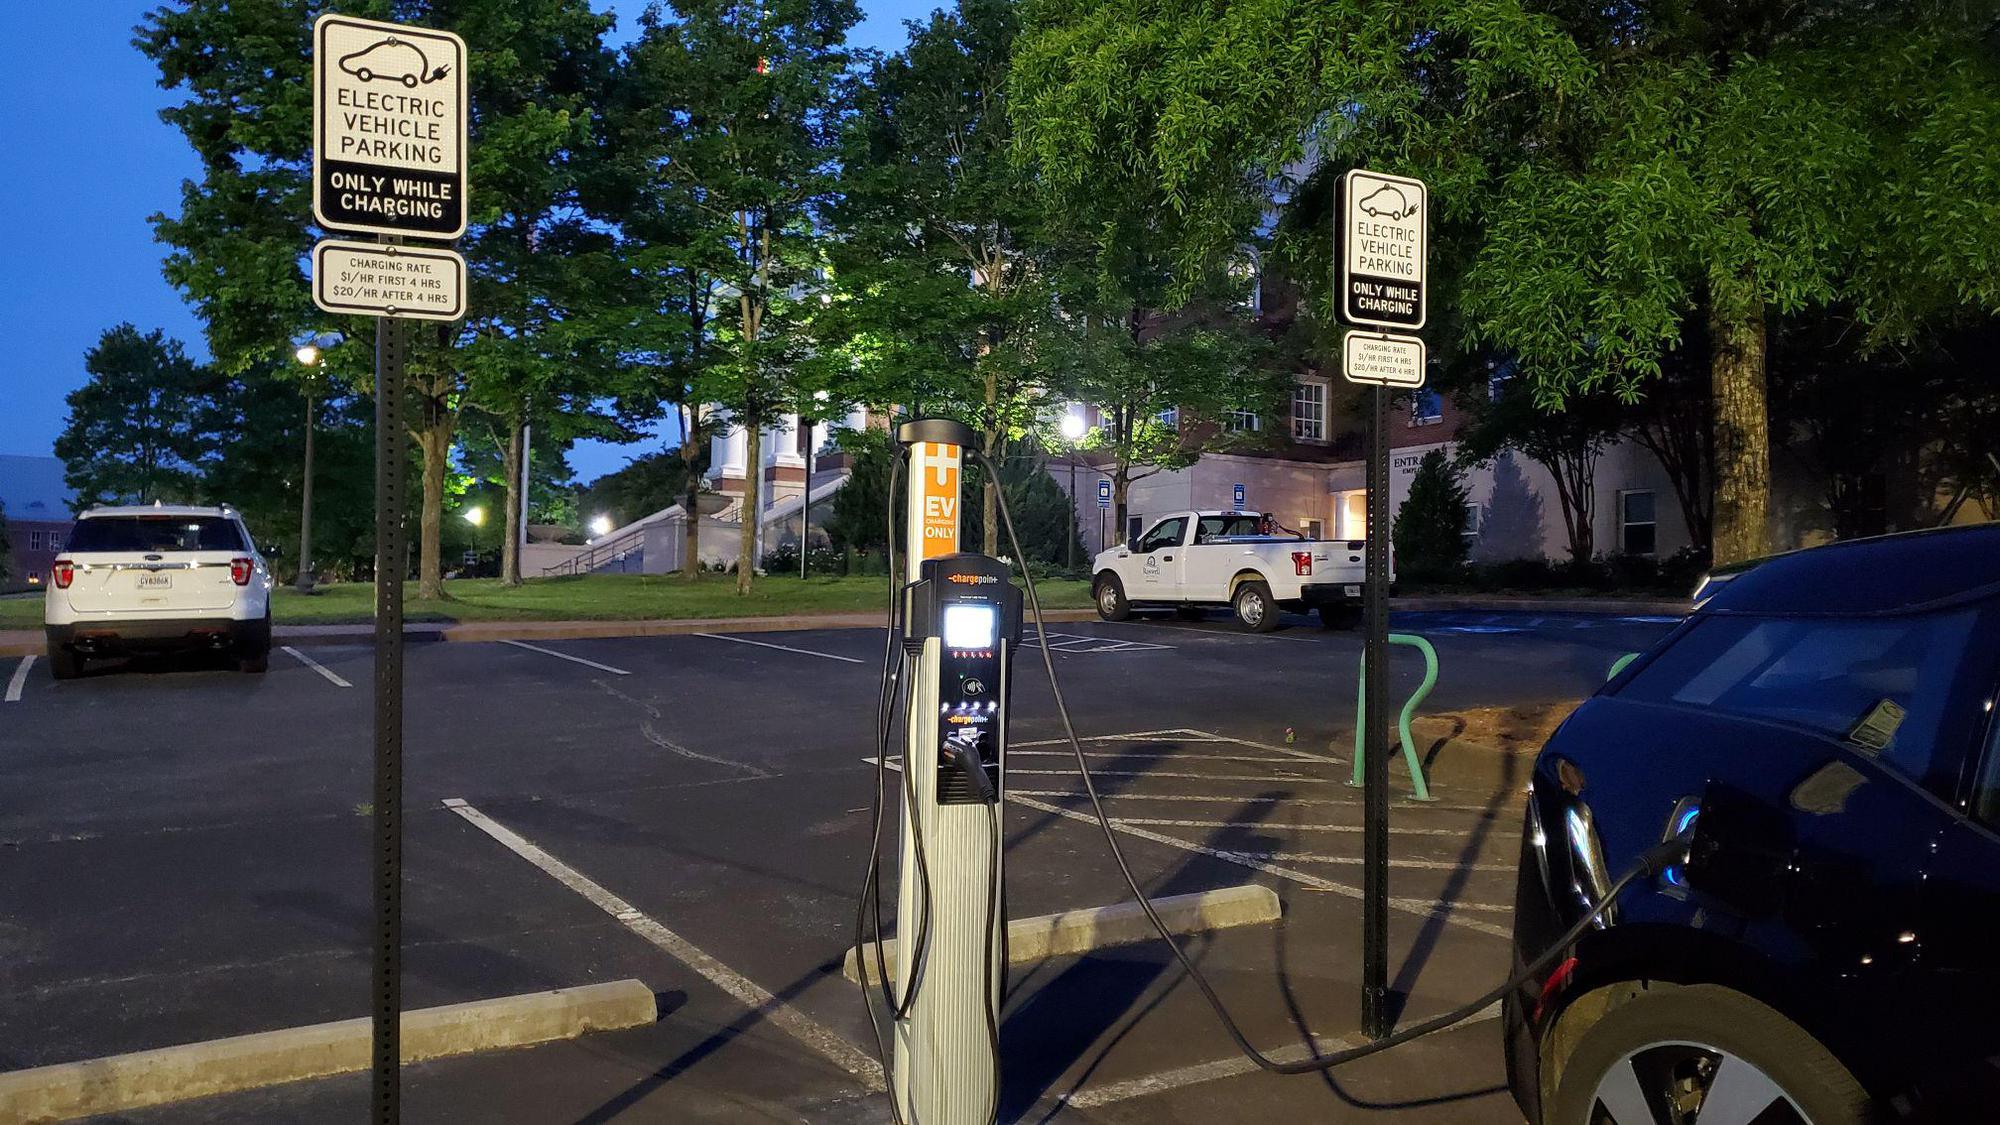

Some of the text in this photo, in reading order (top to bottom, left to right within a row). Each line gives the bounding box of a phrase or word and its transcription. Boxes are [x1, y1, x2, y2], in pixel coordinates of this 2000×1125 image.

[338, 88, 445, 118] ELECTRIC
[343, 112, 441, 141] VEHICLE
[341, 136, 442, 164] PARKING
[330, 172, 452, 200] ONLY WHILE
[341, 194, 443, 219] CHARGING
[1358, 222, 1415, 242] ELECTRIC
[1361, 239, 1413, 259] VEHICLE
[350, 258, 432, 274] CHARGING RATE
[1359, 256, 1413, 275] PARKING
[341, 271, 441, 289] $1/HR FIRST 4 HRS
[333, 285, 448, 304] $20/HR AFTER 4 HRS
[1353, 282, 1418, 301] ONLY WHILE
[1358, 297, 1413, 315] CHARGING
[1363, 343, 1407, 354] CHARGING RATE
[1377, 355, 1393, 363] FIRST
[1354, 363, 1378, 372] $20/HR
[1379, 366, 1396, 374] AFTER
[1404, 368, 1415, 376] HRS
[926, 496, 955, 517] EV
[925, 526, 955, 538] ONLY
